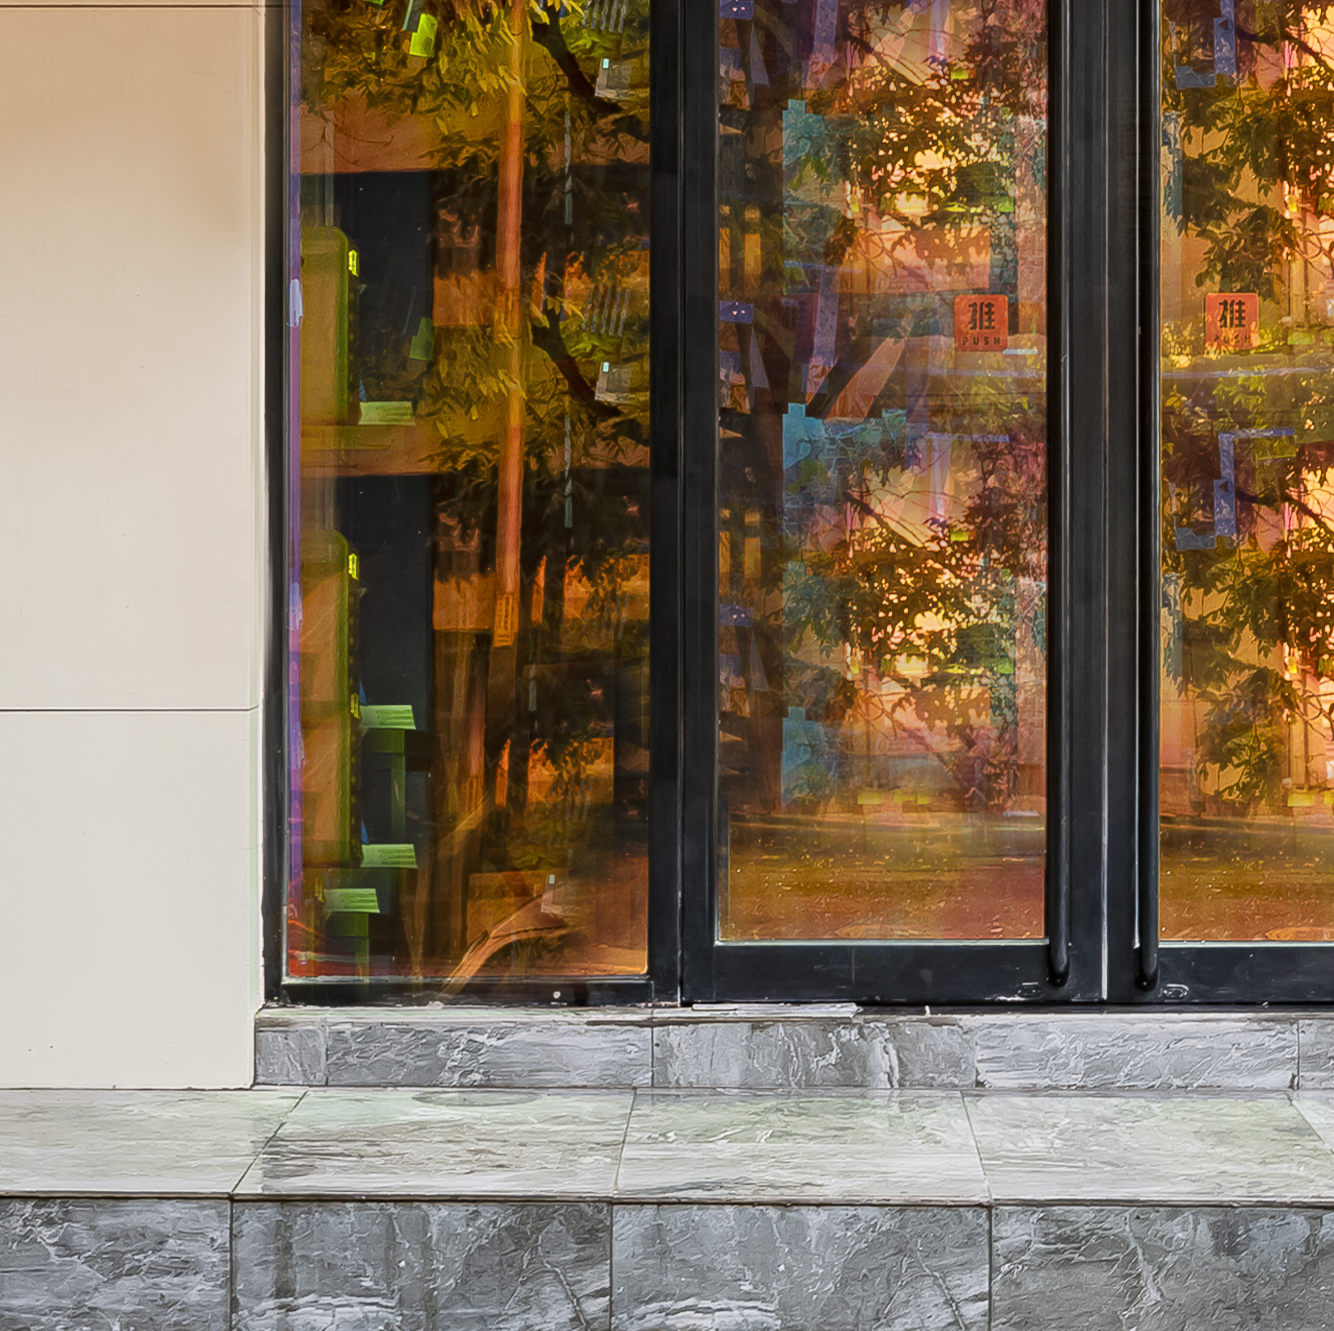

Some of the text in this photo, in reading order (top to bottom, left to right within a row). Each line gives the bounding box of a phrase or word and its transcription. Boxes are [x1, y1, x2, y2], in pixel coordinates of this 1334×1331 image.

[967, 301, 996, 331] 推
[1218, 299, 1246, 329] 推
[962, 336, 1000, 346] PUSH
